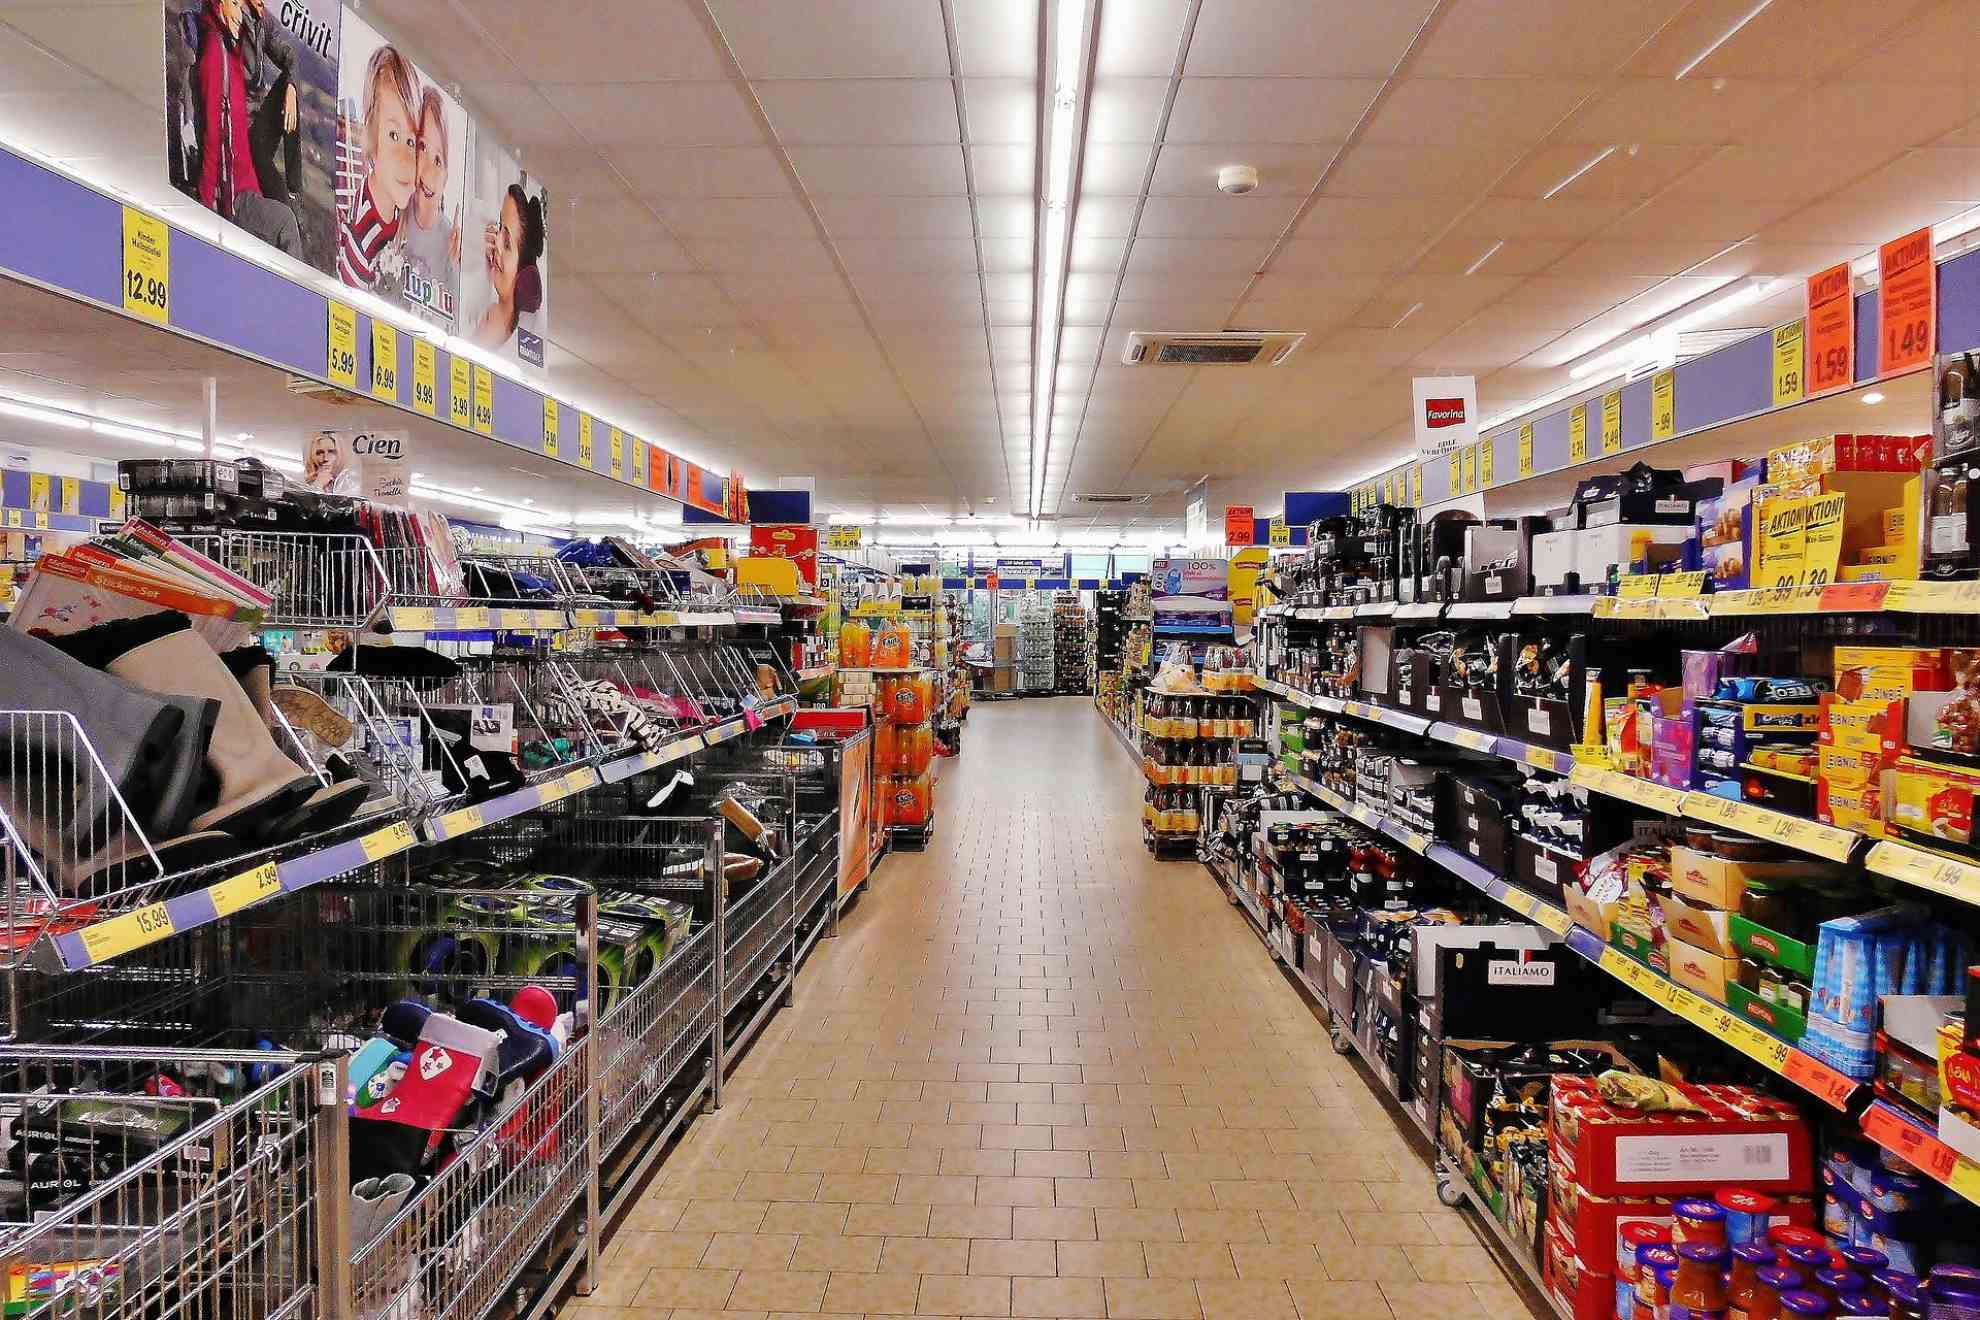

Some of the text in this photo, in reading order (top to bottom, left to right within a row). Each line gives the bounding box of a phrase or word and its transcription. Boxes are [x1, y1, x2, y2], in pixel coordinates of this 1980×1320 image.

[281, 2, 332, 59] crivit
[127, 269, 167, 309] 12.99
[1889, 320, 1929, 362] 1.49
[331, 348, 355, 376] 5.99
[1815, 346, 1848, 384] 1.59
[375, 365, 395, 391] 6.99
[1778, 371, 1799, 398] 1.59
[416, 382, 434, 406] 9.99
[453, 396, 469, 417] 3.99
[1427, 408, 1464, 420] Favorina
[352, 434, 402, 455] Cien
[256, 868, 279, 889] 2.99
[136, 907, 170, 934] 15.99
[1493, 966, 1550, 977] ITALIAMO
[31, 1179, 82, 1189] AUROL
